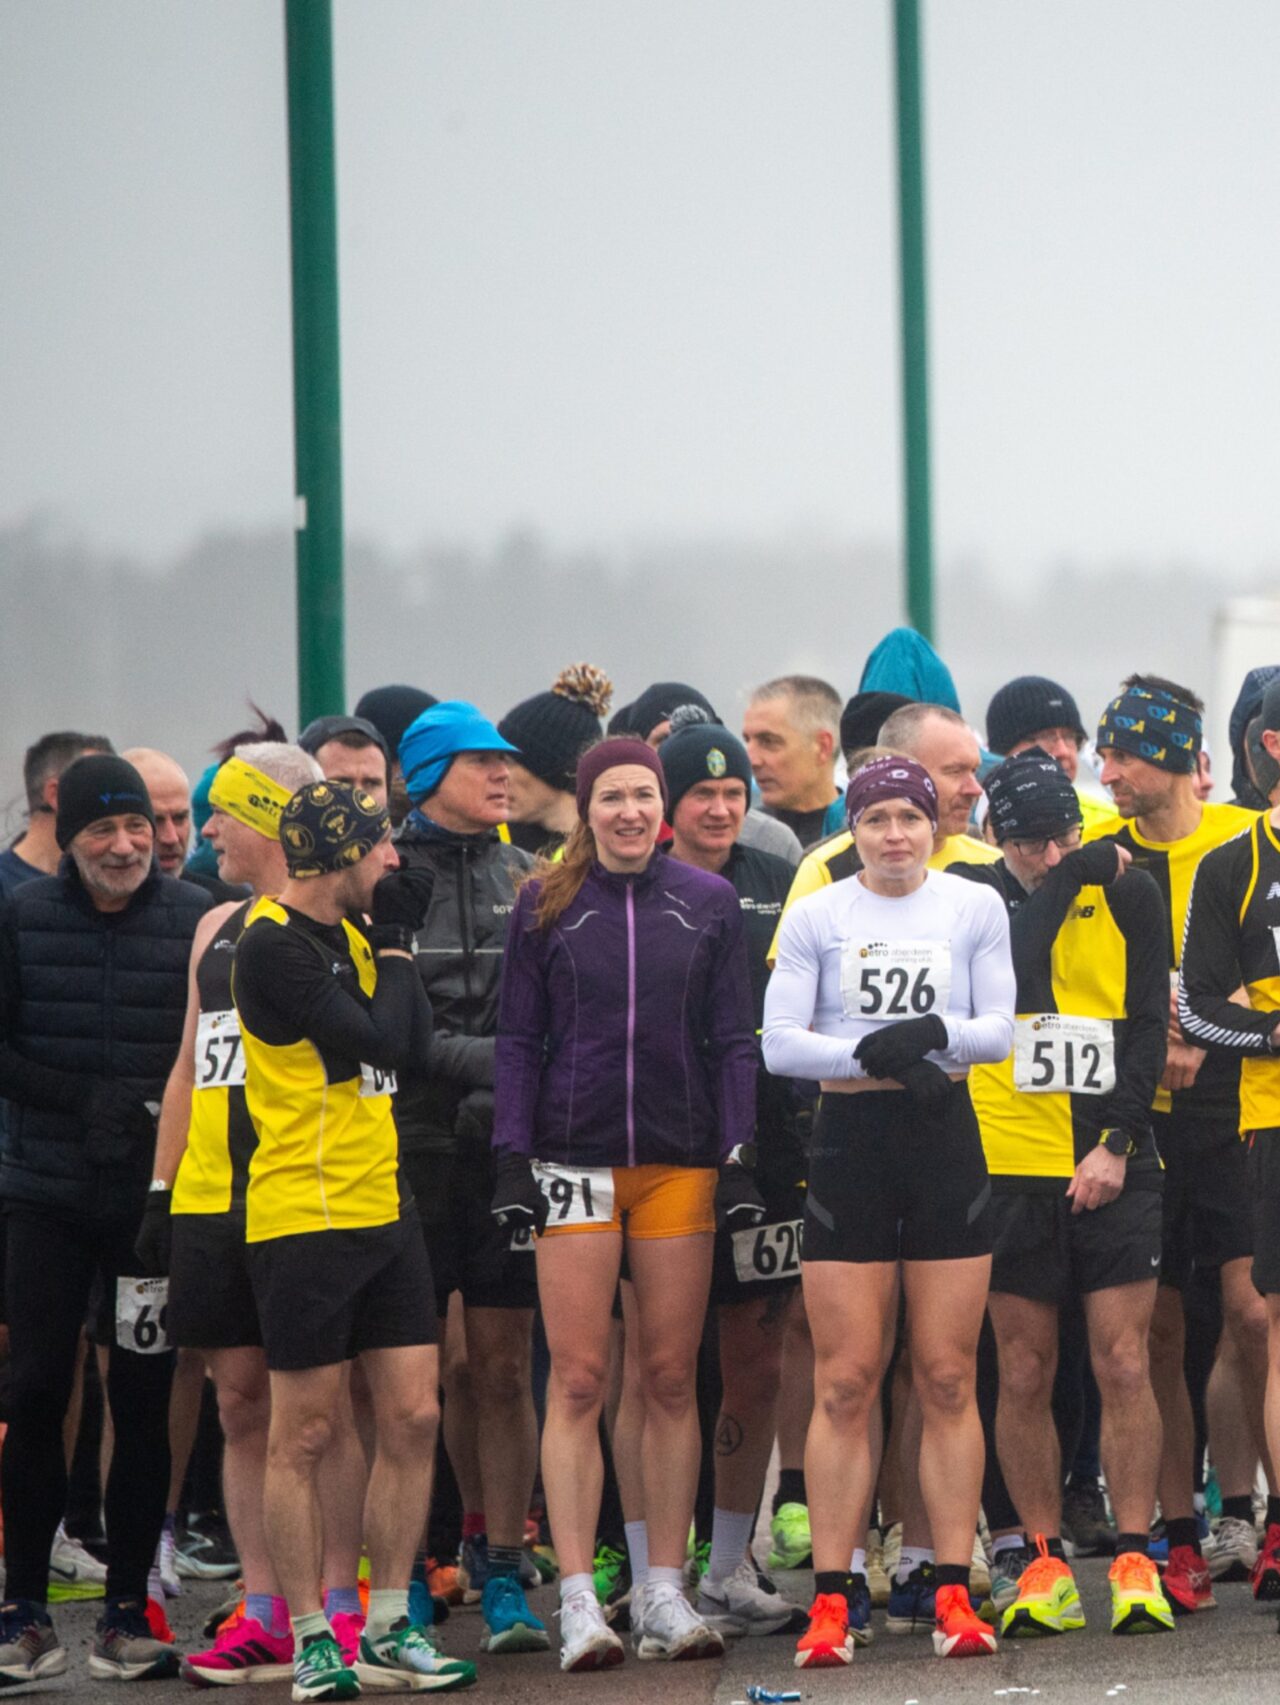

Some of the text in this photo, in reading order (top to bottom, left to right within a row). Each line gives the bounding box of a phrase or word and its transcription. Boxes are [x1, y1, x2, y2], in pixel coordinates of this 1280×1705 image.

[860, 967, 936, 1015] 526
[202, 1035, 247, 1083] 57
[1031, 1041, 1102, 1089] 512
[537, 1178, 594, 1219] 91
